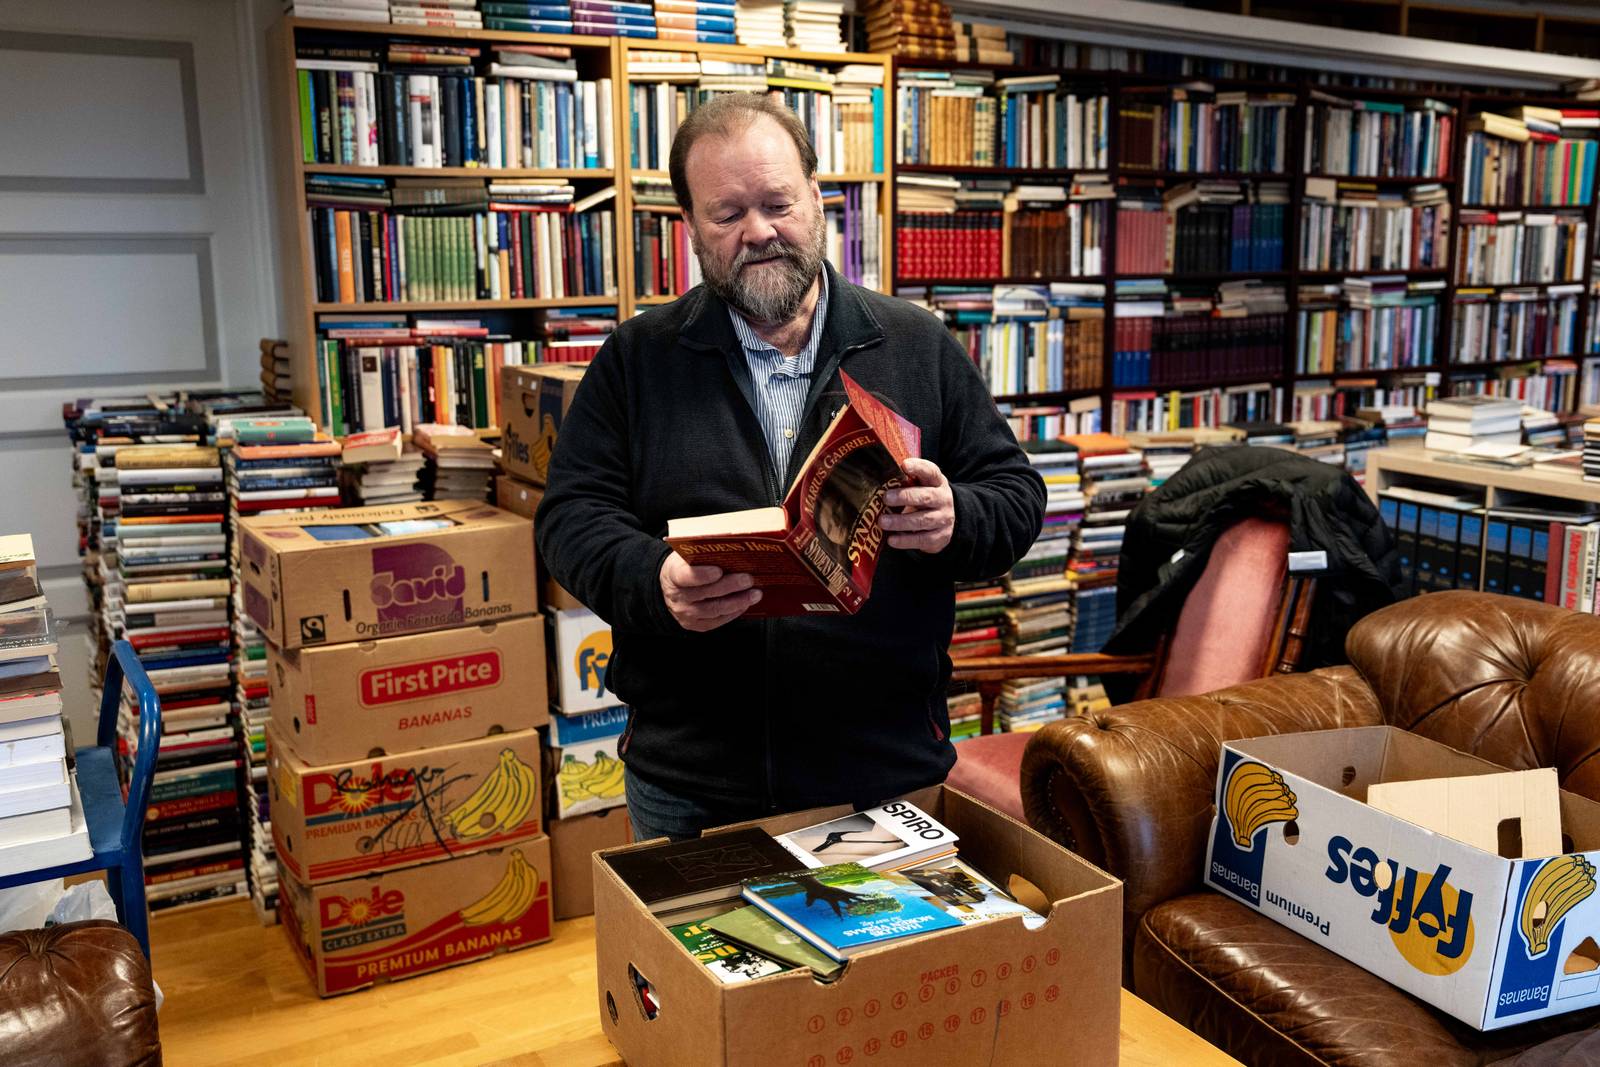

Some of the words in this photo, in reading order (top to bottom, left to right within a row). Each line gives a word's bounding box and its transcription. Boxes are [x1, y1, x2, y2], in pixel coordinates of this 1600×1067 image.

[804, 467, 828, 516] MARIUS
[823, 435, 876, 470] GABRIEL
[848, 477, 902, 567] SYNDENS
[680, 544, 745, 554] SYNDENS
[804, 537, 834, 578] SYNDENS
[356, 620, 402, 637] Organic
[407, 609, 461, 627] Fairtrade
[464, 604, 513, 619] Bananas
[370, 671, 429, 699] First
[432, 661, 492, 690] Price
[398, 706, 473, 730] BANANAS
[305, 821, 362, 841] PREMIUM
[882, 801, 945, 841] SPIRO
[1212, 861, 1260, 900] Bananas
[1324, 835, 1474, 959] Fyffes
[319, 885, 405, 930] Dole
[1265, 889, 1331, 937] Premium
[325, 933, 363, 950] CLASS
[366, 924, 405, 939] EXTRA
[357, 948, 441, 979] PREMIUM
[444, 925, 523, 957] BANANAS
[920, 964, 960, 984] PACKER
[1498, 984, 1550, 1007] Bananas
